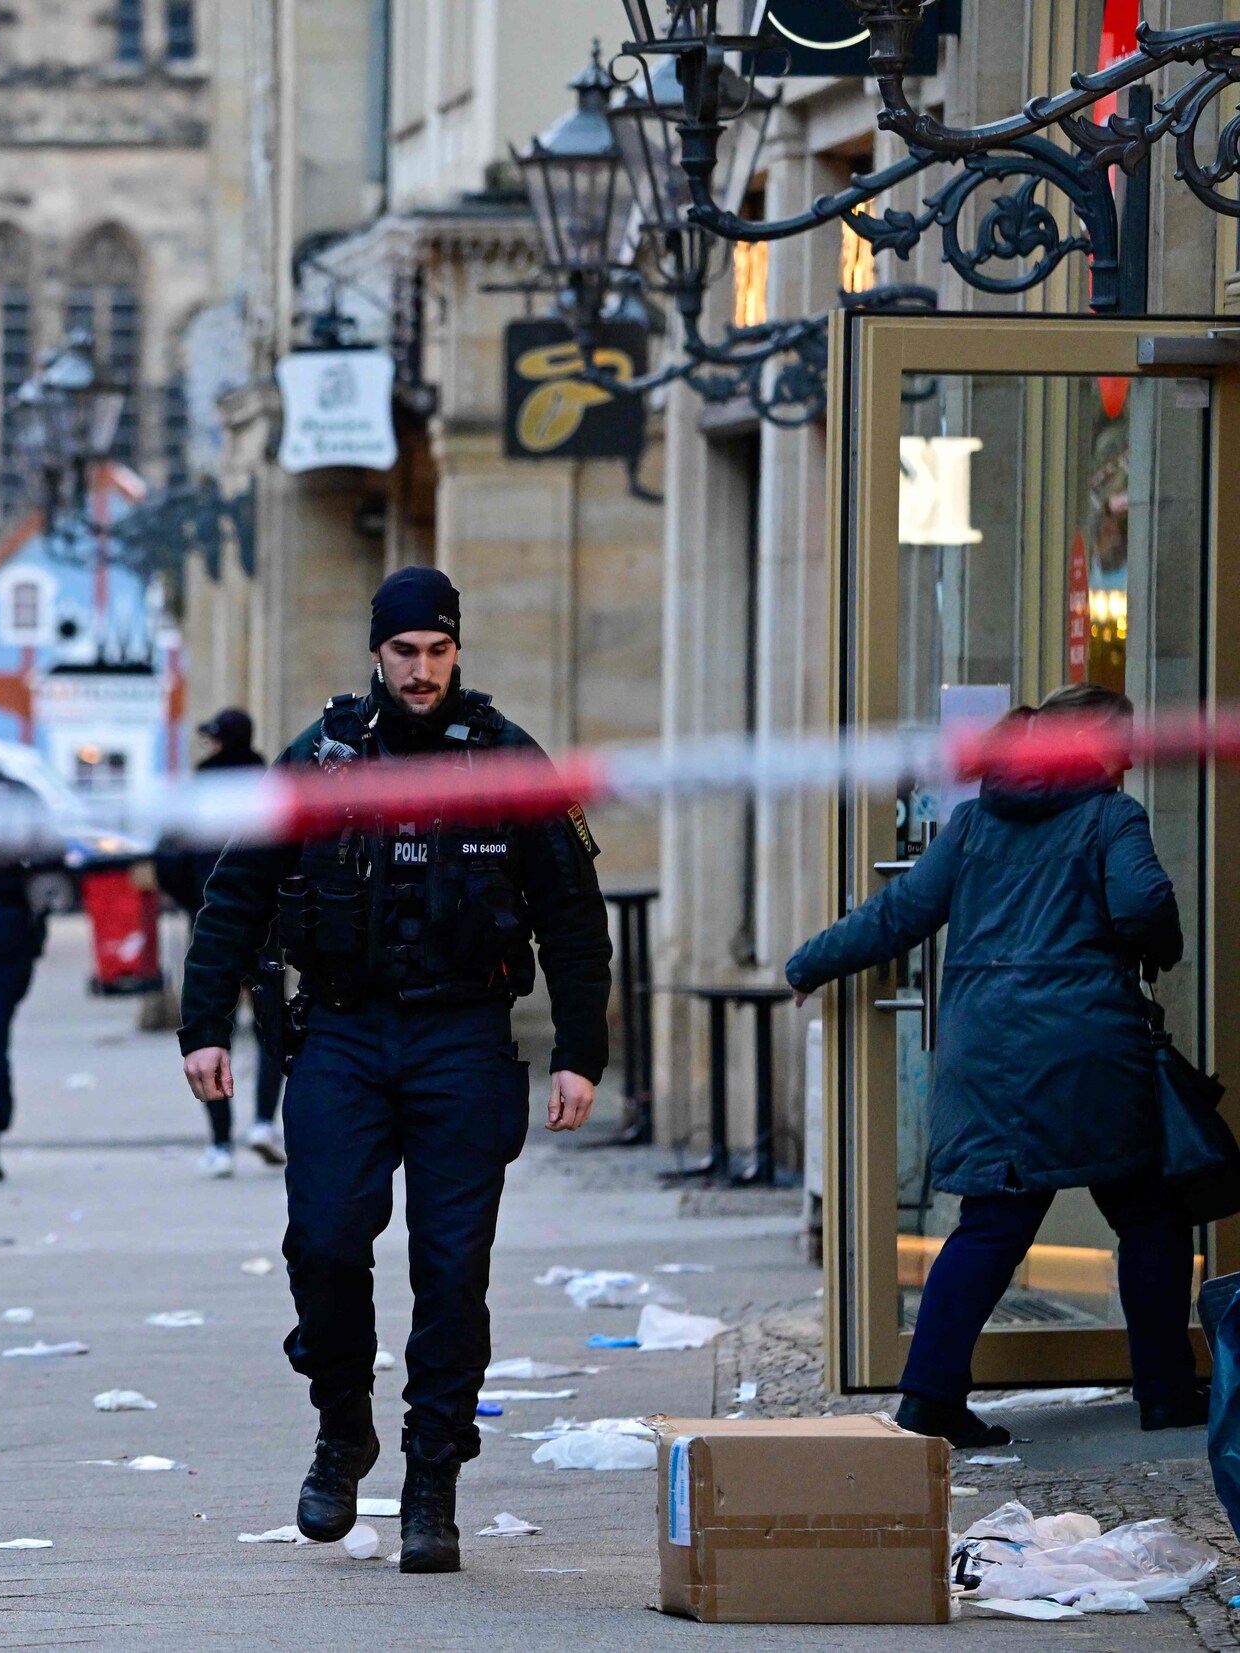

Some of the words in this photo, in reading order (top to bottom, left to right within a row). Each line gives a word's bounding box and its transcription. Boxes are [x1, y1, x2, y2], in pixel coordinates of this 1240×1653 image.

[394, 842, 428, 862] POLIZ
[462, 843, 478, 853] SN
[479, 843, 507, 853] 64000
